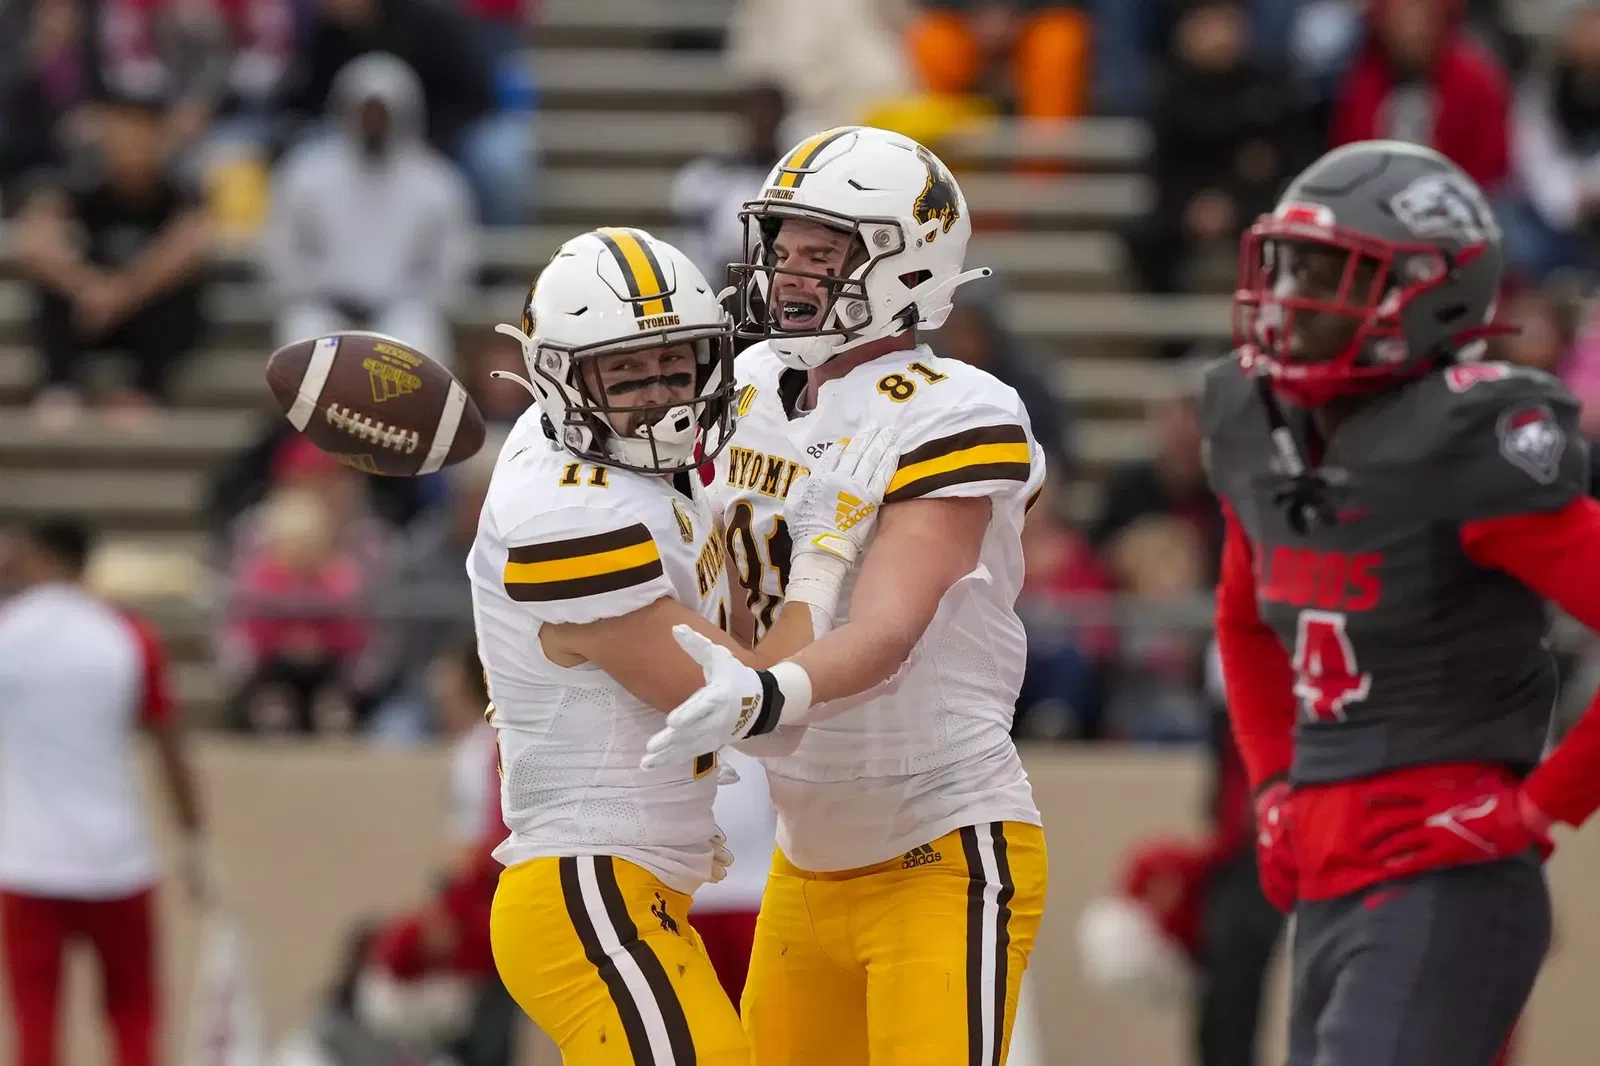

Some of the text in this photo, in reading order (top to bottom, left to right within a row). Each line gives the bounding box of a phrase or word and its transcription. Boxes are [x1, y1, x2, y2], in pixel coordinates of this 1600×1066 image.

[763, 188, 796, 201] WYOMING
[636, 314, 681, 331] WYOMING
[876, 361, 949, 403] 81
[558, 462, 610, 487] 11
[837, 502, 876, 533] adidas
[1258, 546, 1385, 612] LOBOS
[1292, 609, 1373, 723] 4
[731, 692, 761, 736] adidas
[901, 851, 942, 869] adidas
